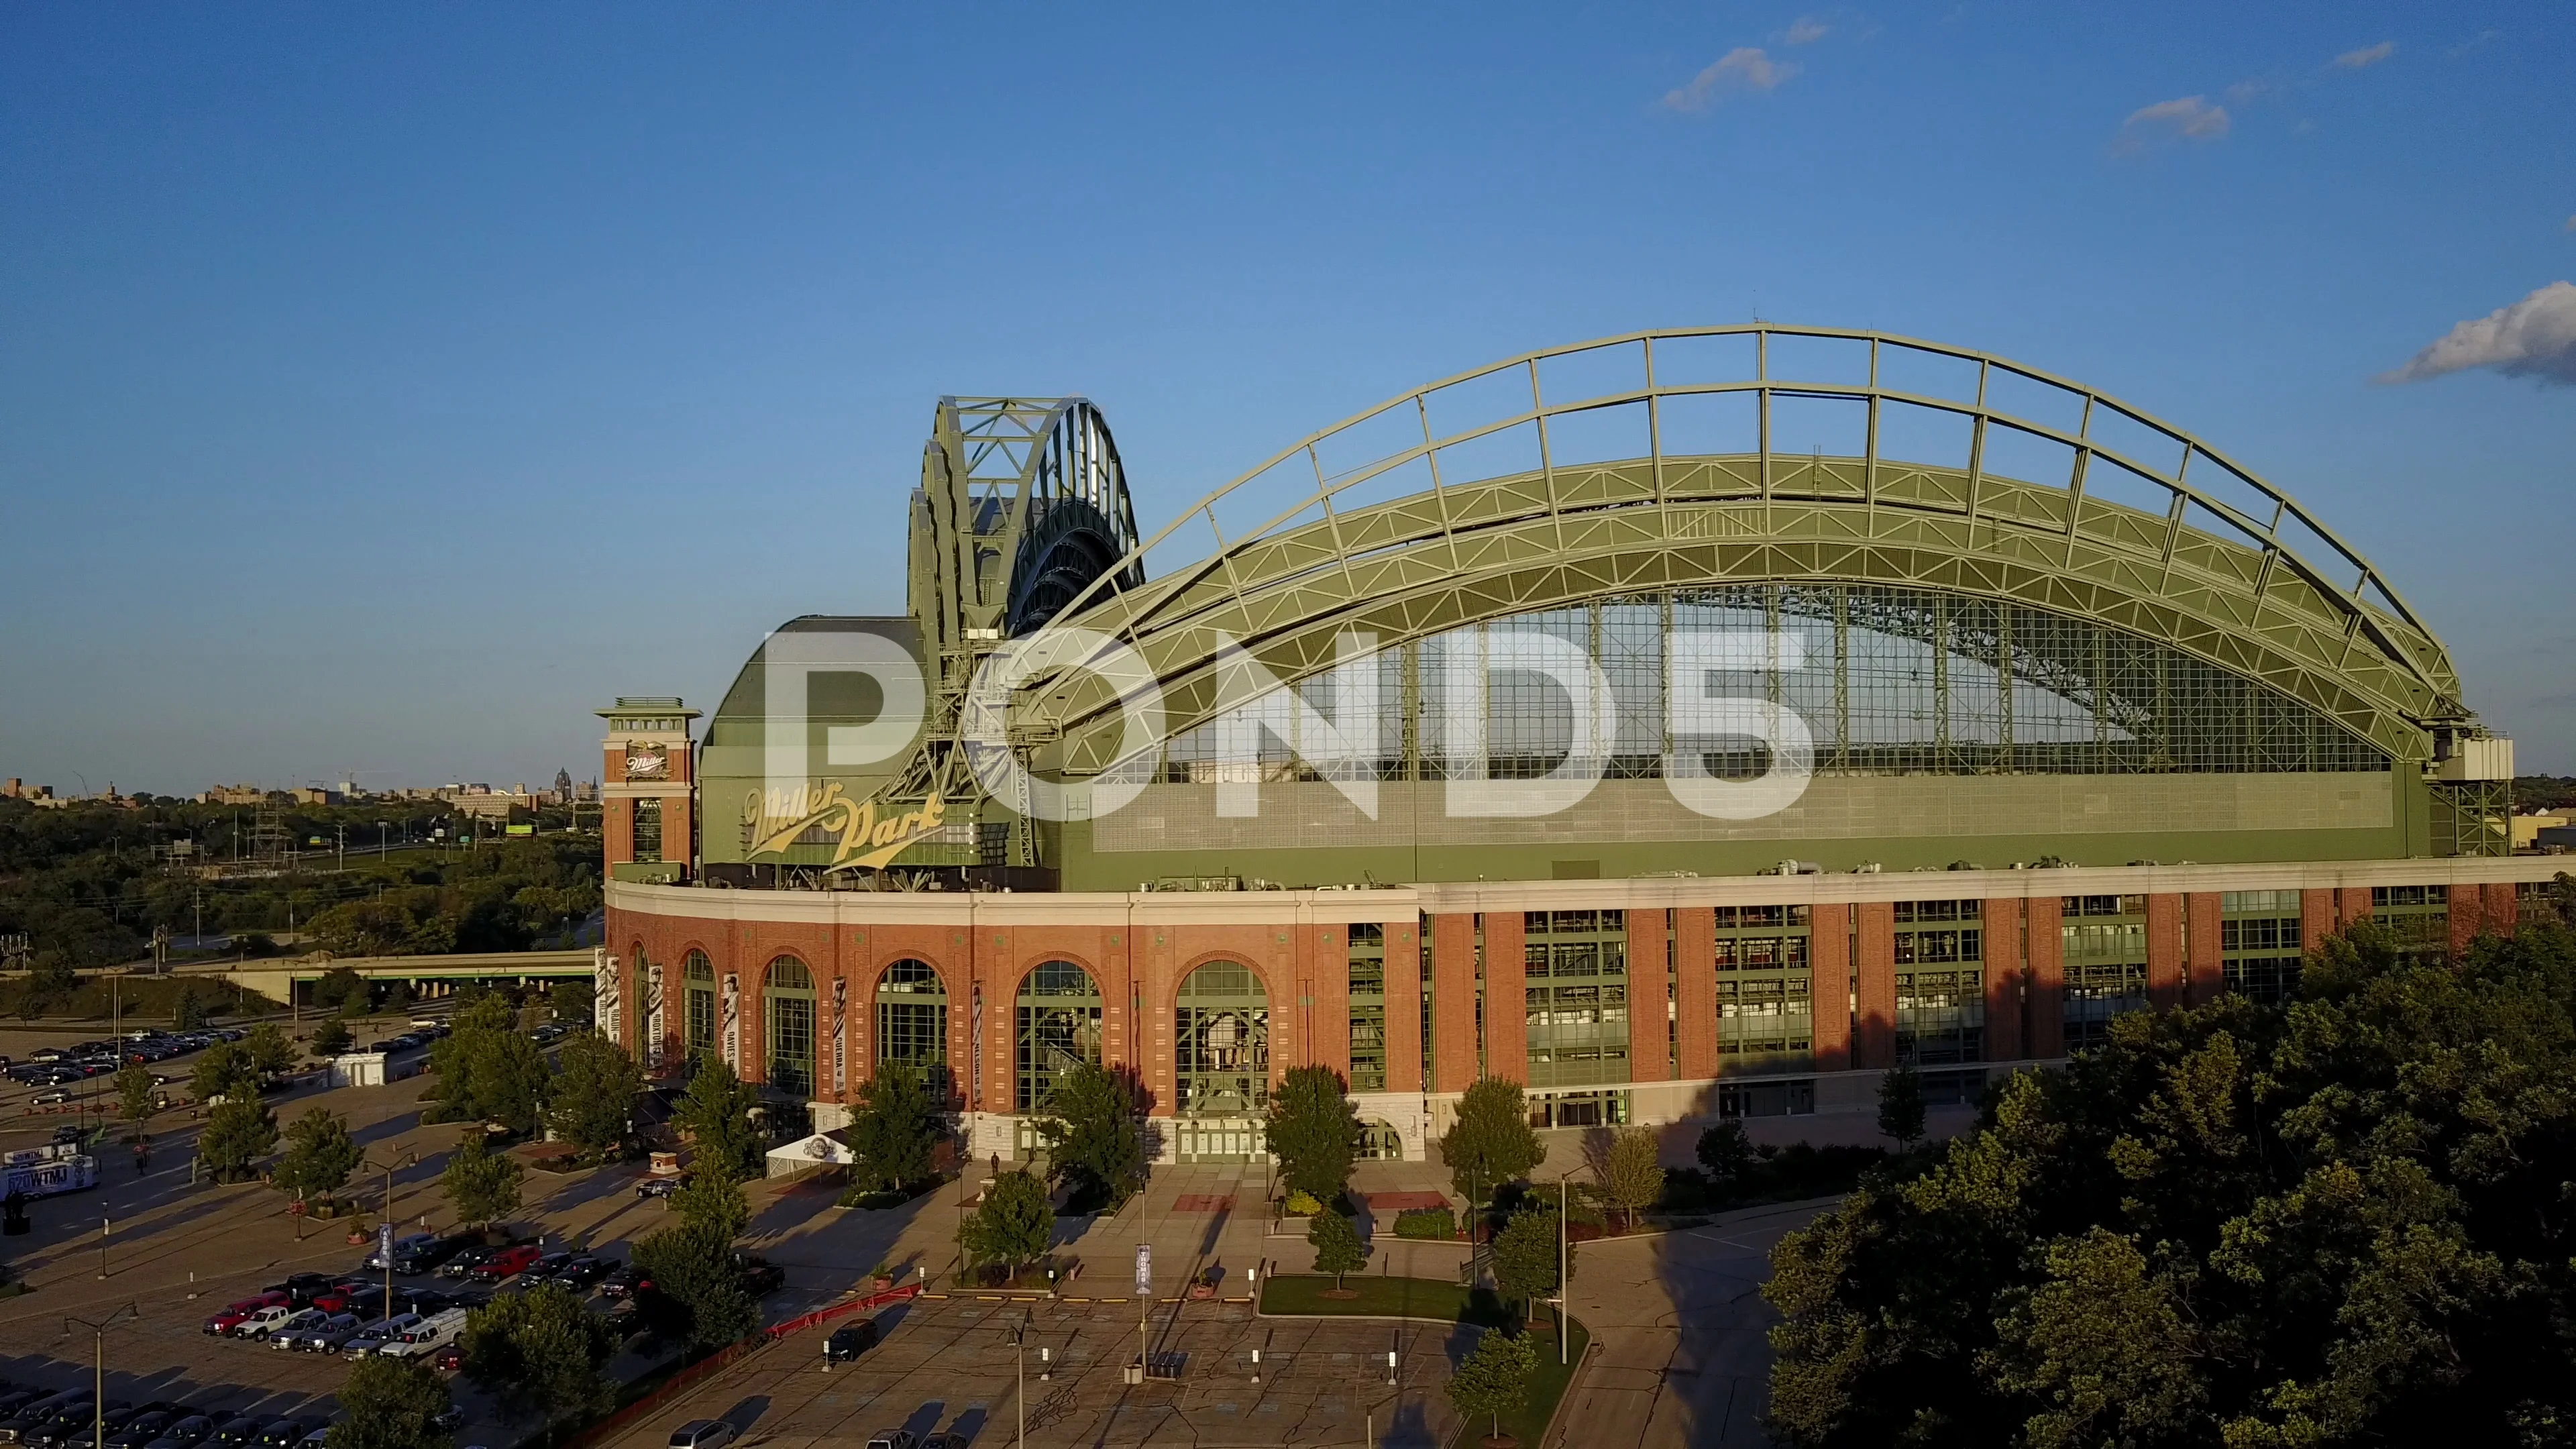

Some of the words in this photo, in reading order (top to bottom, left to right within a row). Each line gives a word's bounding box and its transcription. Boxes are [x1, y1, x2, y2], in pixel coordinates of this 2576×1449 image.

[627, 757, 666, 773] Miller
[745, 782, 843, 861] Miller
[822, 790, 945, 875] Park
[610, 1008, 620, 1031] BRAUN
[653, 1014, 661, 1045] BROXTON
[727, 1031, 735, 1057] DAVIES
